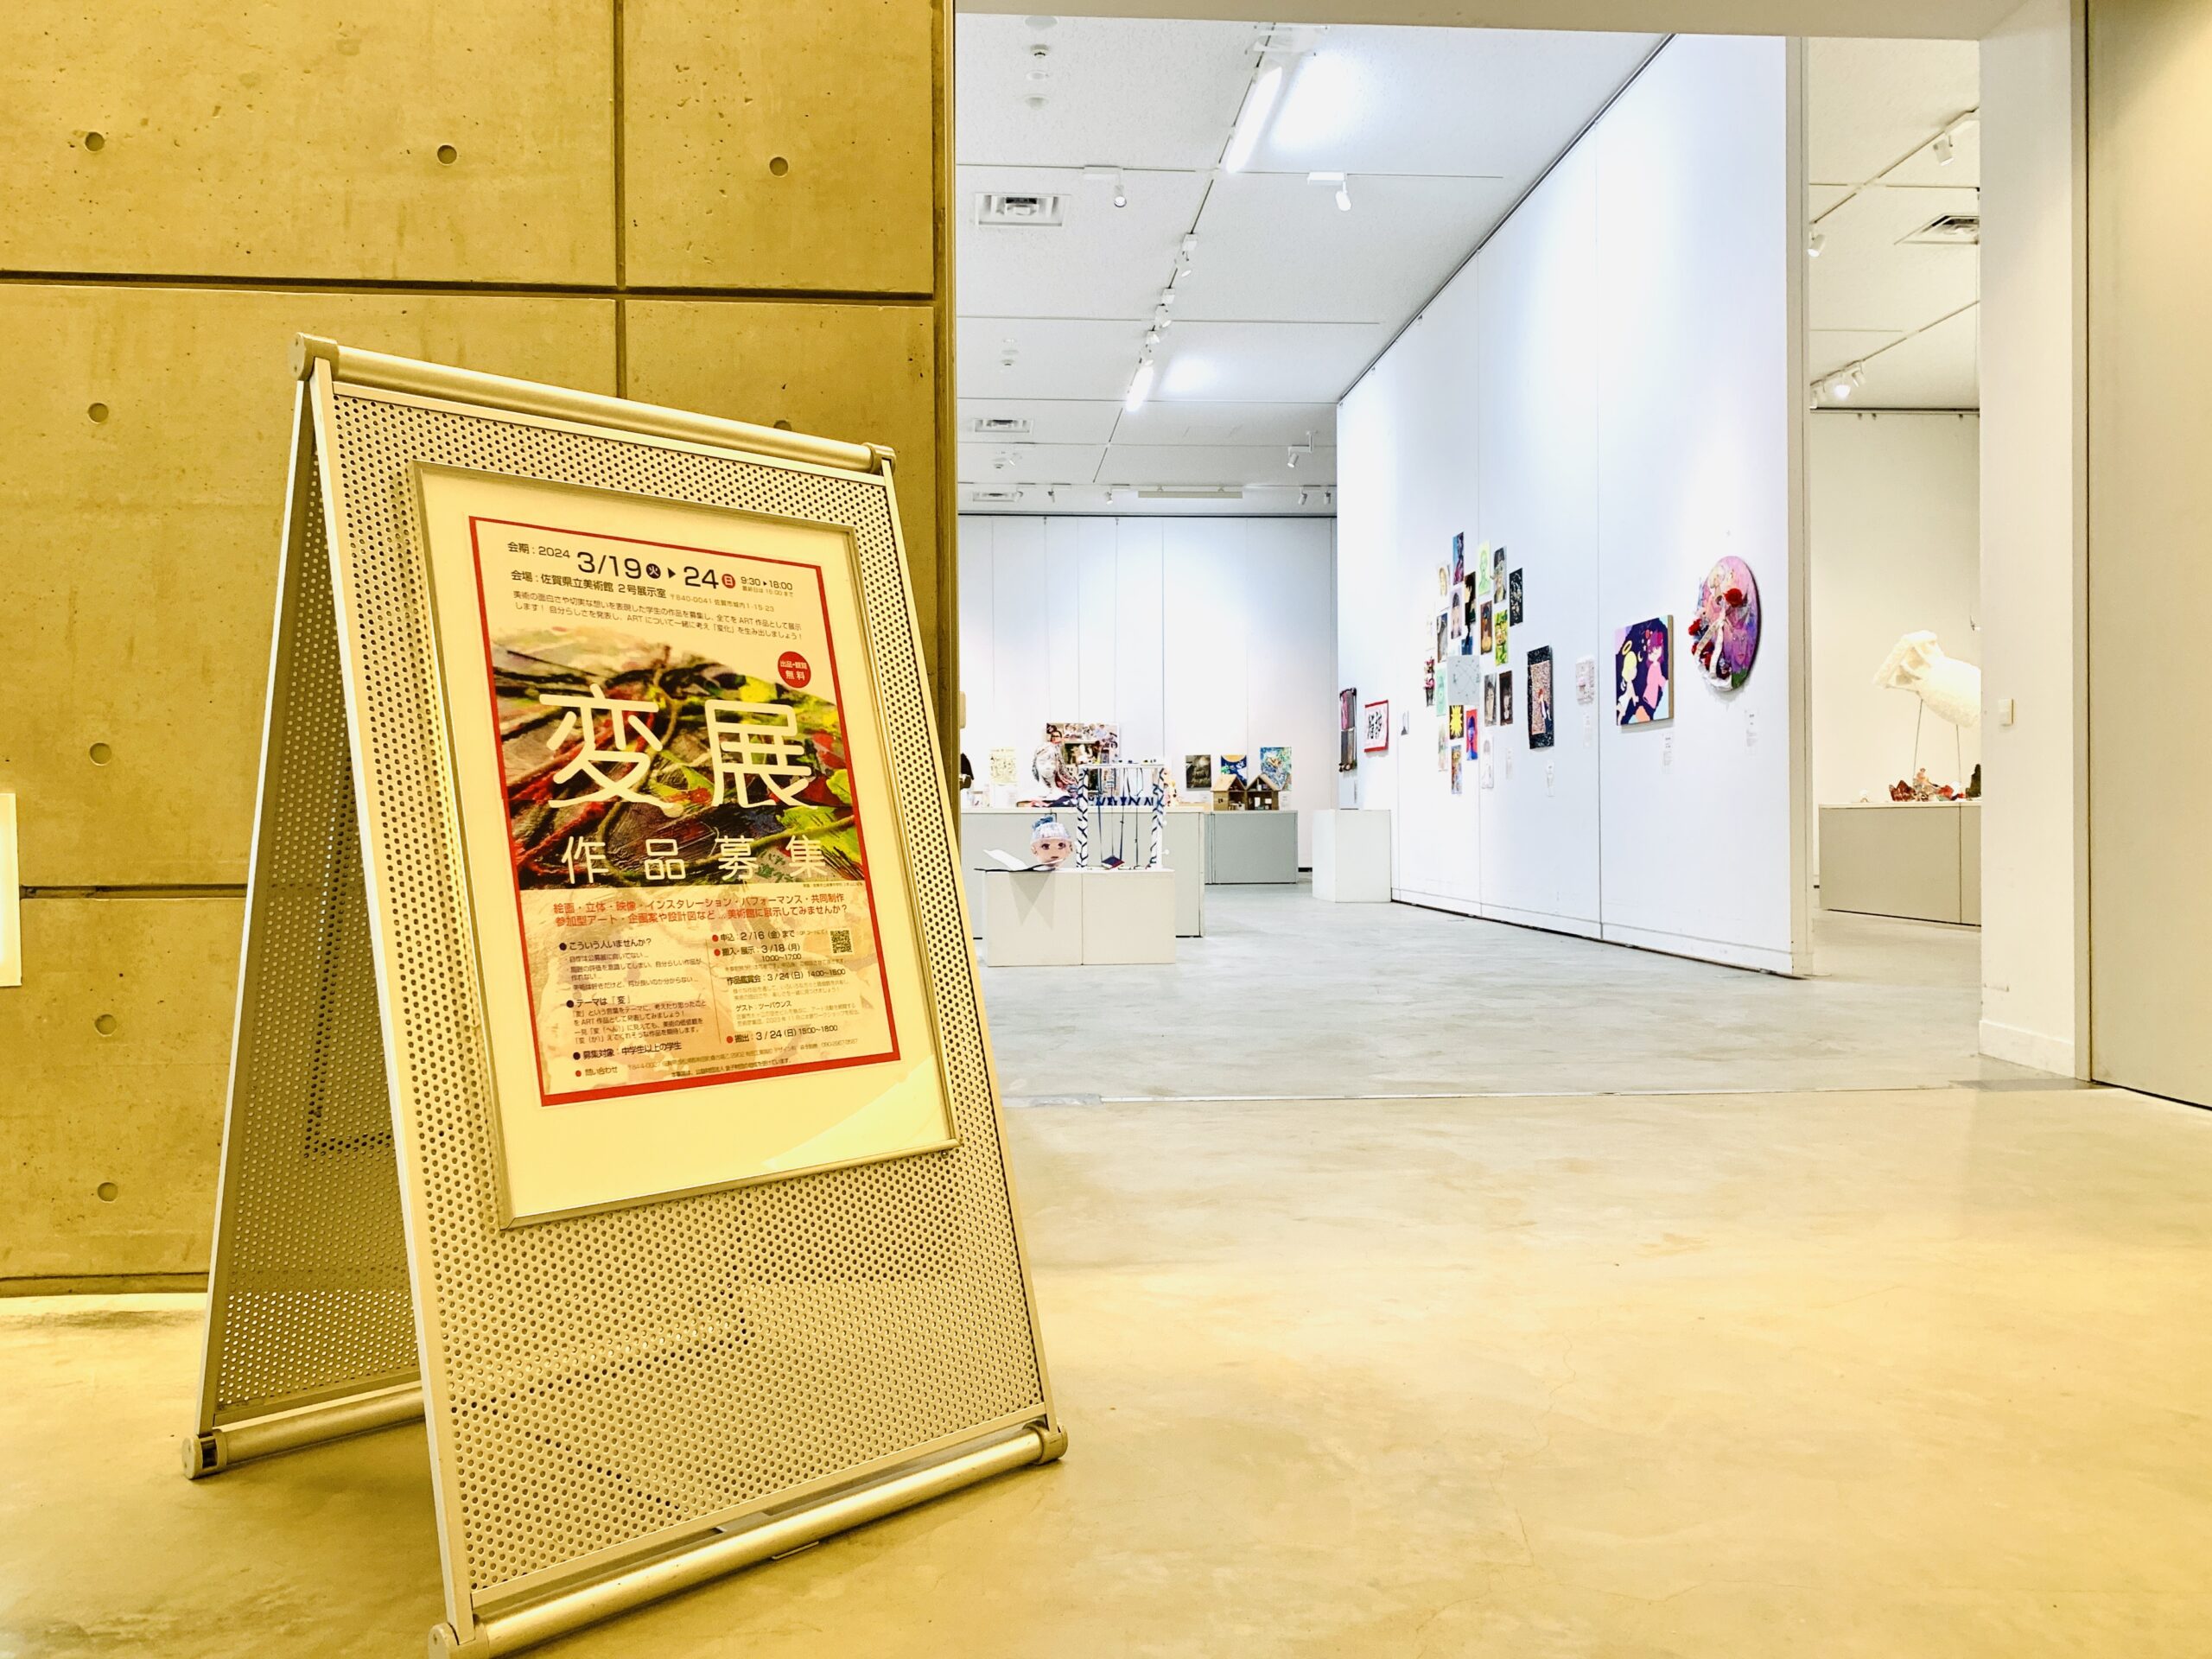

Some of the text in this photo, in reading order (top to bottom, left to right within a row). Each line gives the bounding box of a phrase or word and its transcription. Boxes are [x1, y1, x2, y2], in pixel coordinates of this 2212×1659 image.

[577, 551, 642, 579] 3/19
[647, 564, 660, 578] 火
[683, 566, 719, 589] 24
[741, 576, 760, 587] 9:30
[769, 580, 793, 591] 18:00
[562, 835, 827, 884] 作品募集
[569, 938, 652, 950] こういう人いませんか？
